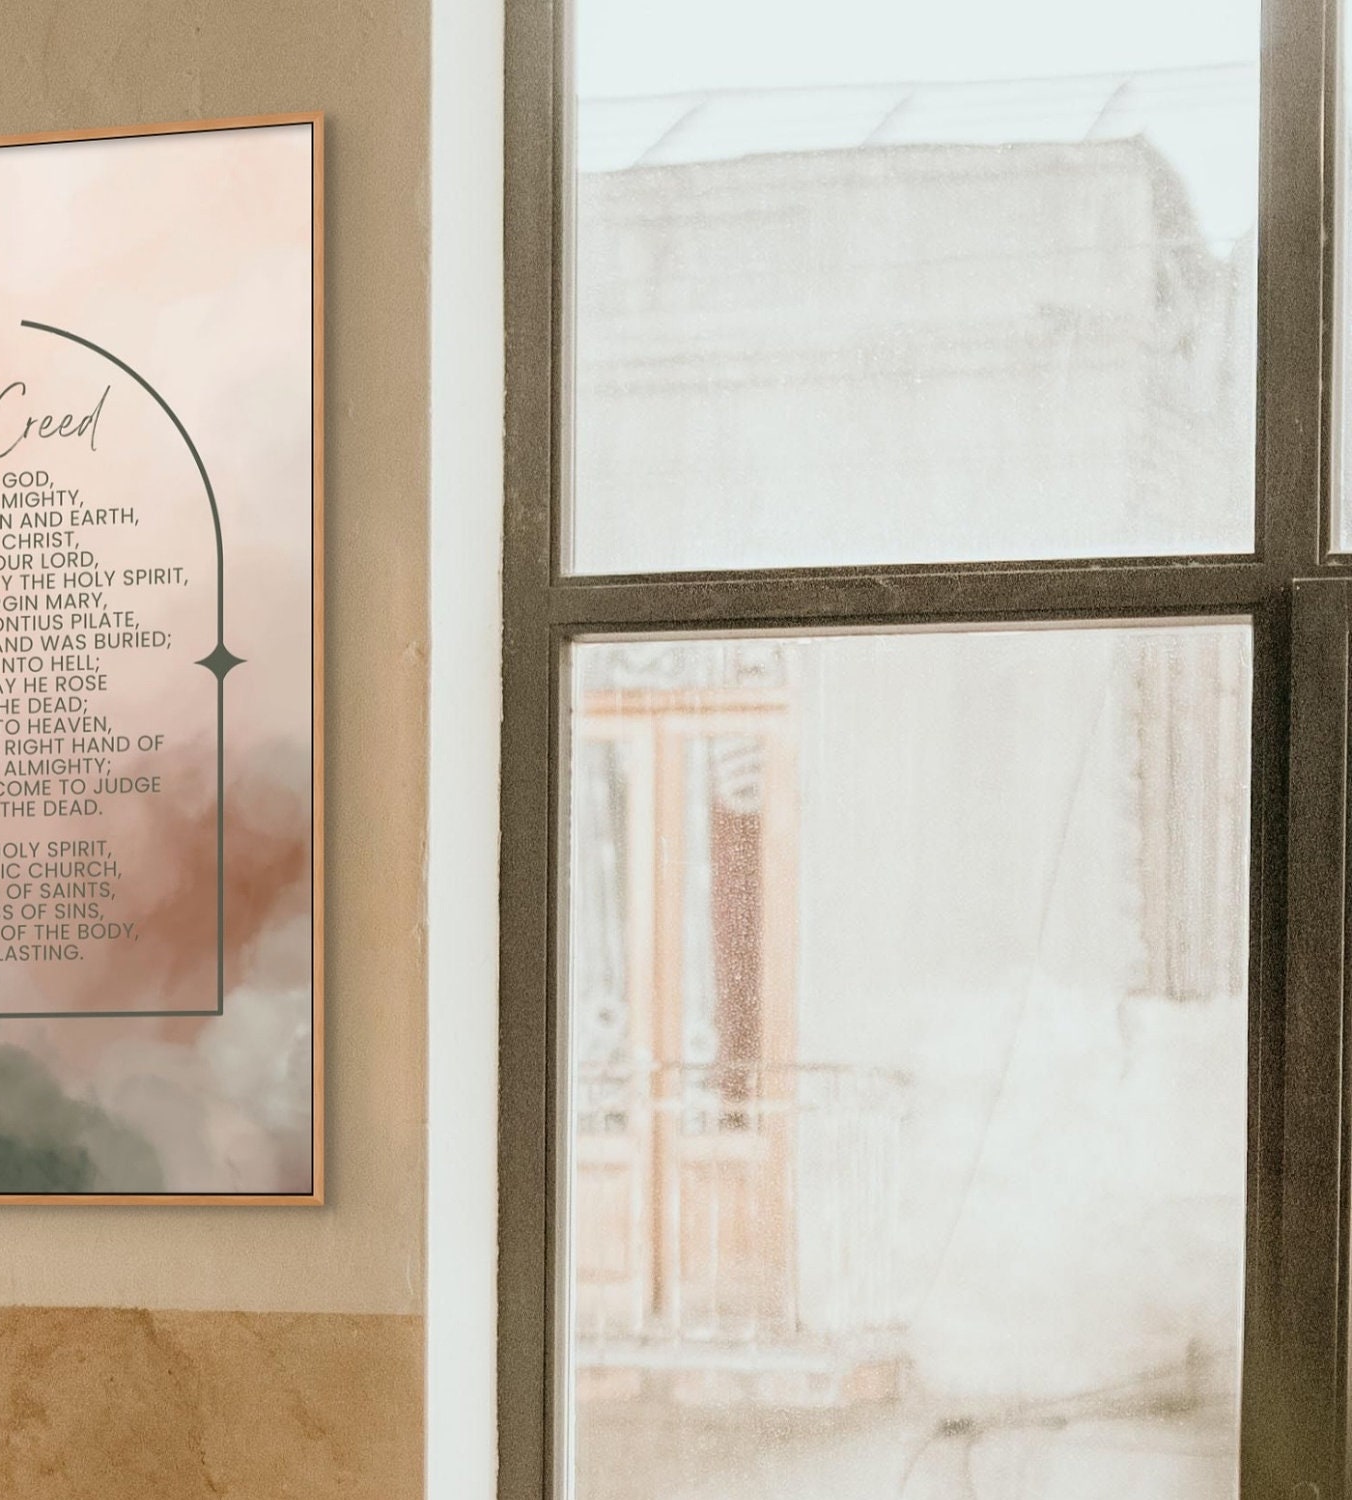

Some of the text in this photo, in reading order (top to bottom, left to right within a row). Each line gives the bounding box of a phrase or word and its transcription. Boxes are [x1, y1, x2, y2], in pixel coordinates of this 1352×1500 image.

[1, 471, 55, 489] GOD,
[19, 511, 64, 529] AND
[70, 507, 140, 527] EARTH,
[1, 531, 80, 550] CHRIST,
[40, 551, 99, 570] LORD,
[20, 573, 57, 590] THE
[63, 571, 116, 589] HOLY
[122, 568, 189, 586] SPIRIT,
[45, 592, 108, 611] MARY,
[70, 611, 140, 630] PILATE,
[39, 634, 87, 651] WAS
[94, 631, 172, 649] BURIED;
[50, 655, 100, 673] HELL;
[23, 677, 48, 694] HE
[55, 675, 108, 692] ROSE
[27, 696, 88, 715] DEAD;
[27, 716, 112, 735] HEAVEN,
[4, 738, 65, 756] RIGHT
[71, 736, 131, 753] HAND
[137, 735, 165, 751] OF
[3, 758, 111, 776] ALMIGHTY;
[58, 779, 87, 795] TO
[93, 776, 161, 794] JUDGE
[0, 801, 36, 817] THE
[43, 799, 103, 816] DEAD.
[47, 840, 112, 859] SPIRIT,
[28, 861, 122, 879] CHURCH,
[6, 883, 33, 899] OF
[39, 882, 116, 900] SAINTS,
[20, 904, 48, 920] OF
[54, 903, 104, 920] SINS,
[0, 925, 28, 941] OF
[33, 924, 70, 940] THE
[77, 923, 138, 940] BODY,
